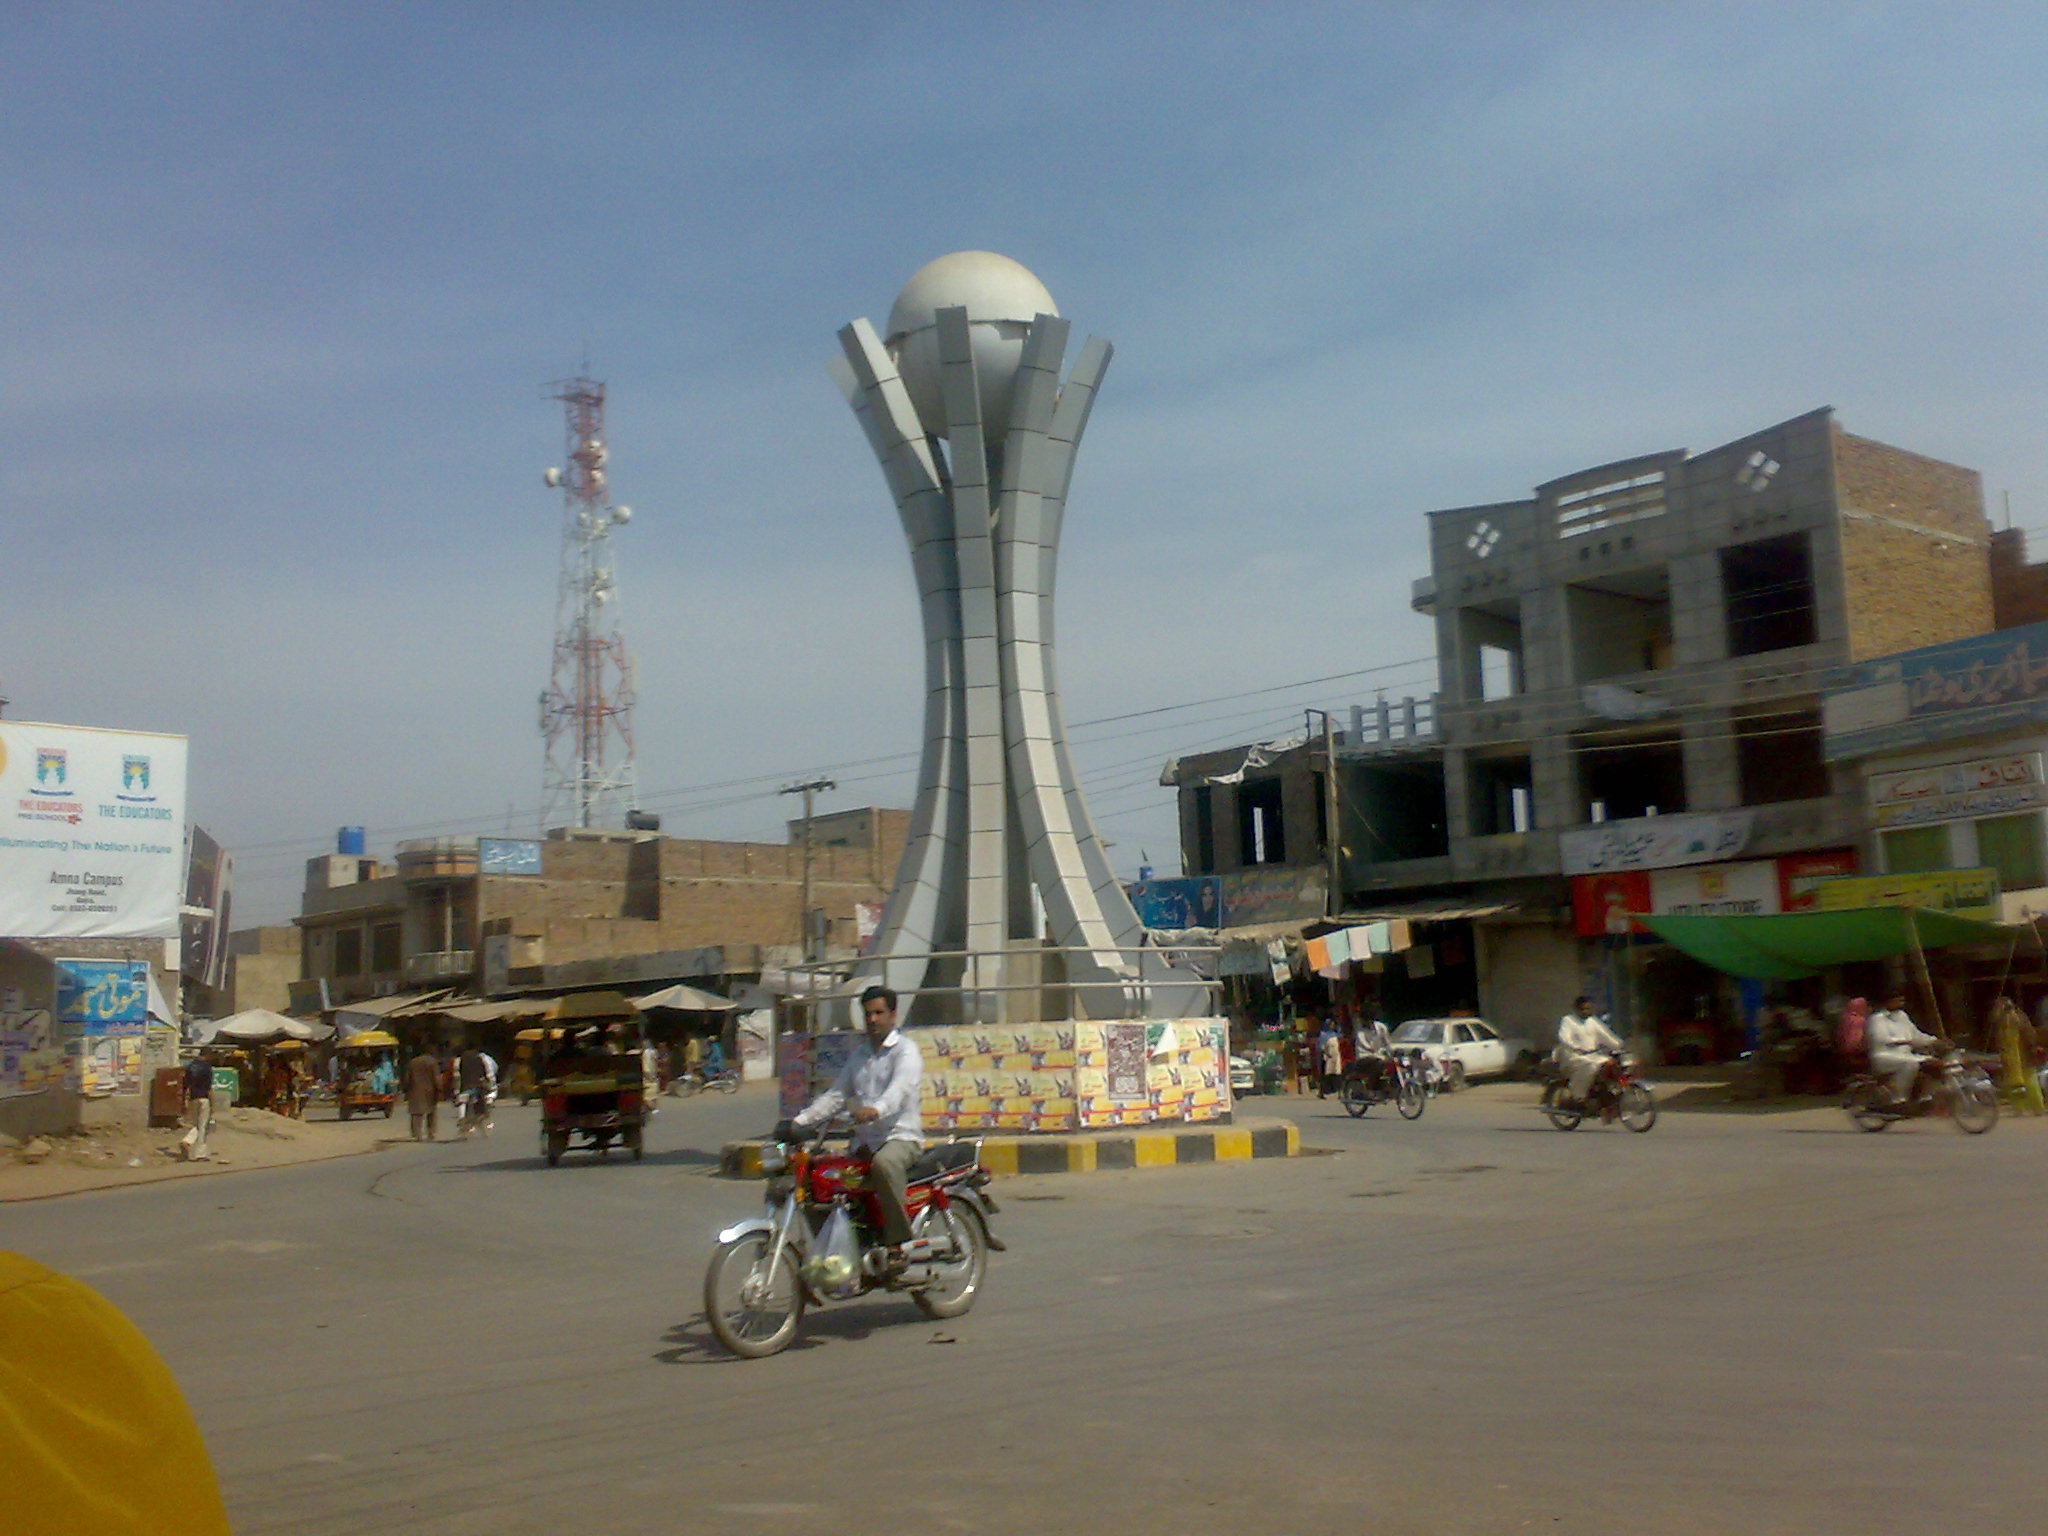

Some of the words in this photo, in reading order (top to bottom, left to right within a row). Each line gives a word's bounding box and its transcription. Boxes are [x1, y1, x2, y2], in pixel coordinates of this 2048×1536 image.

[37, 800, 82, 813] EDUCATORS
[99, 804, 116, 818] THE
[119, 806, 173, 821] EDUCATORS
[72, 840, 92, 850] The
[140, 843, 173, 854] Future
[83, 871, 124, 887] Campus
